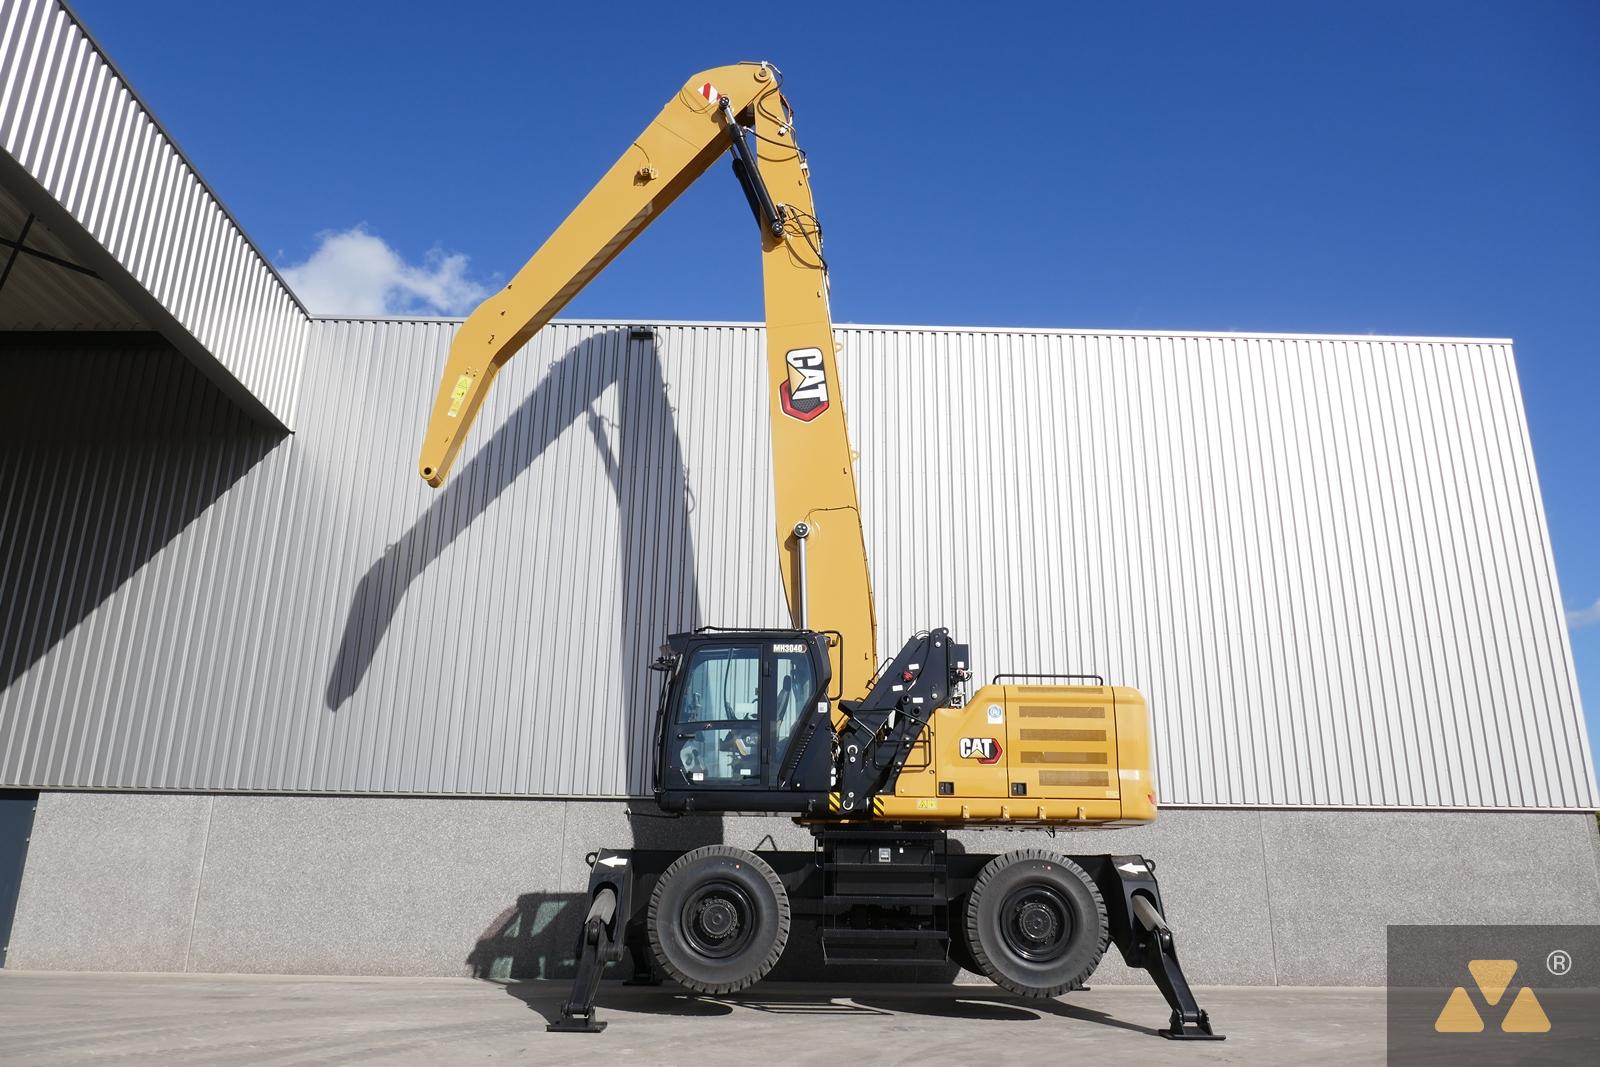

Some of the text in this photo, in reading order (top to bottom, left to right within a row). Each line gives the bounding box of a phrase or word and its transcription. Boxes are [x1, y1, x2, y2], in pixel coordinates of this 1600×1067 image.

[786, 347, 829, 402] CAT
[773, 644, 803, 653] MH3040
[960, 738, 992, 758] CAT
